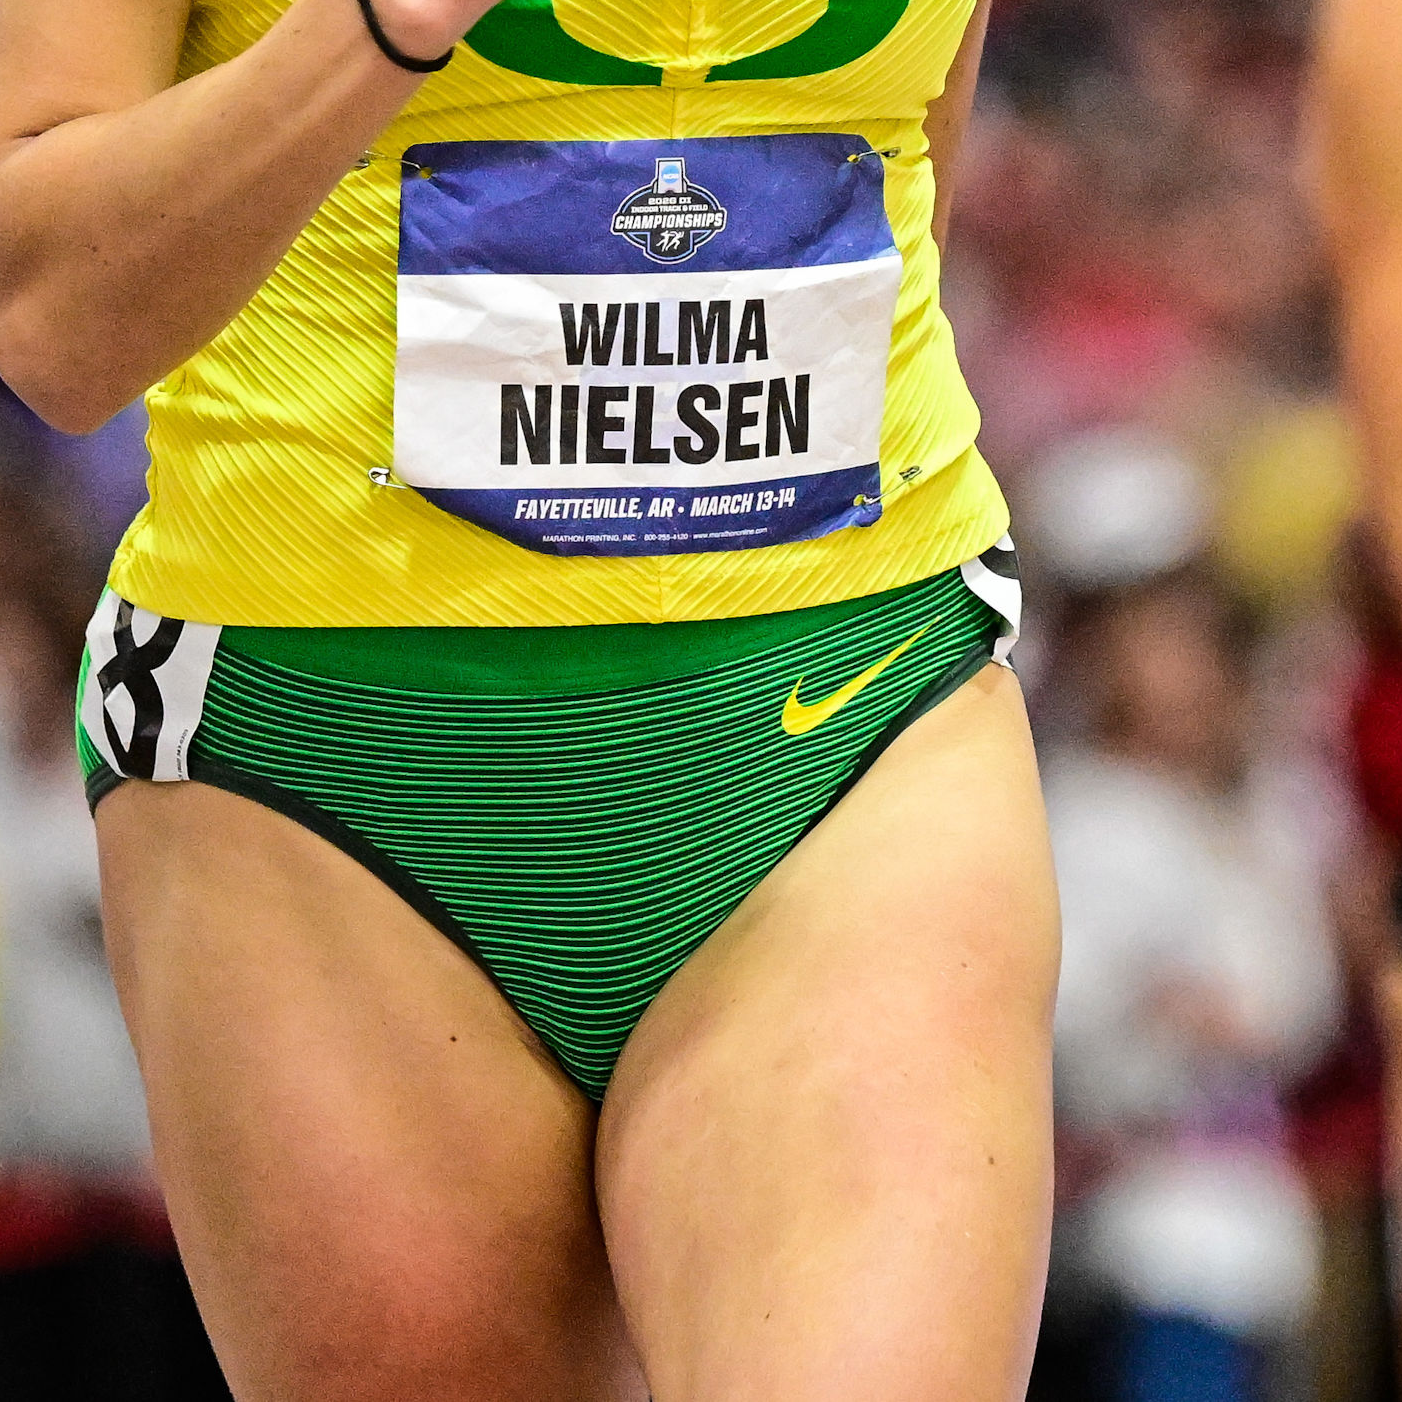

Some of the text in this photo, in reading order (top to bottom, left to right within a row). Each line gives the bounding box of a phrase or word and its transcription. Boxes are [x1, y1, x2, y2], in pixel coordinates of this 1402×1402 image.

[631, 206, 659, 214] INDOOR
[659, 205, 681, 213] TRACK
[648, 197, 677, 205] 2026
[614, 212, 724, 230] CHAMPIONSHIPS
[558, 298, 769, 367] WILMA
[499, 373, 811, 466] NIELSEN
[514, 487, 796, 520] FAYETTEVILLE, AR MARCH 13-14
[542, 534, 584, 543] MARATHON
